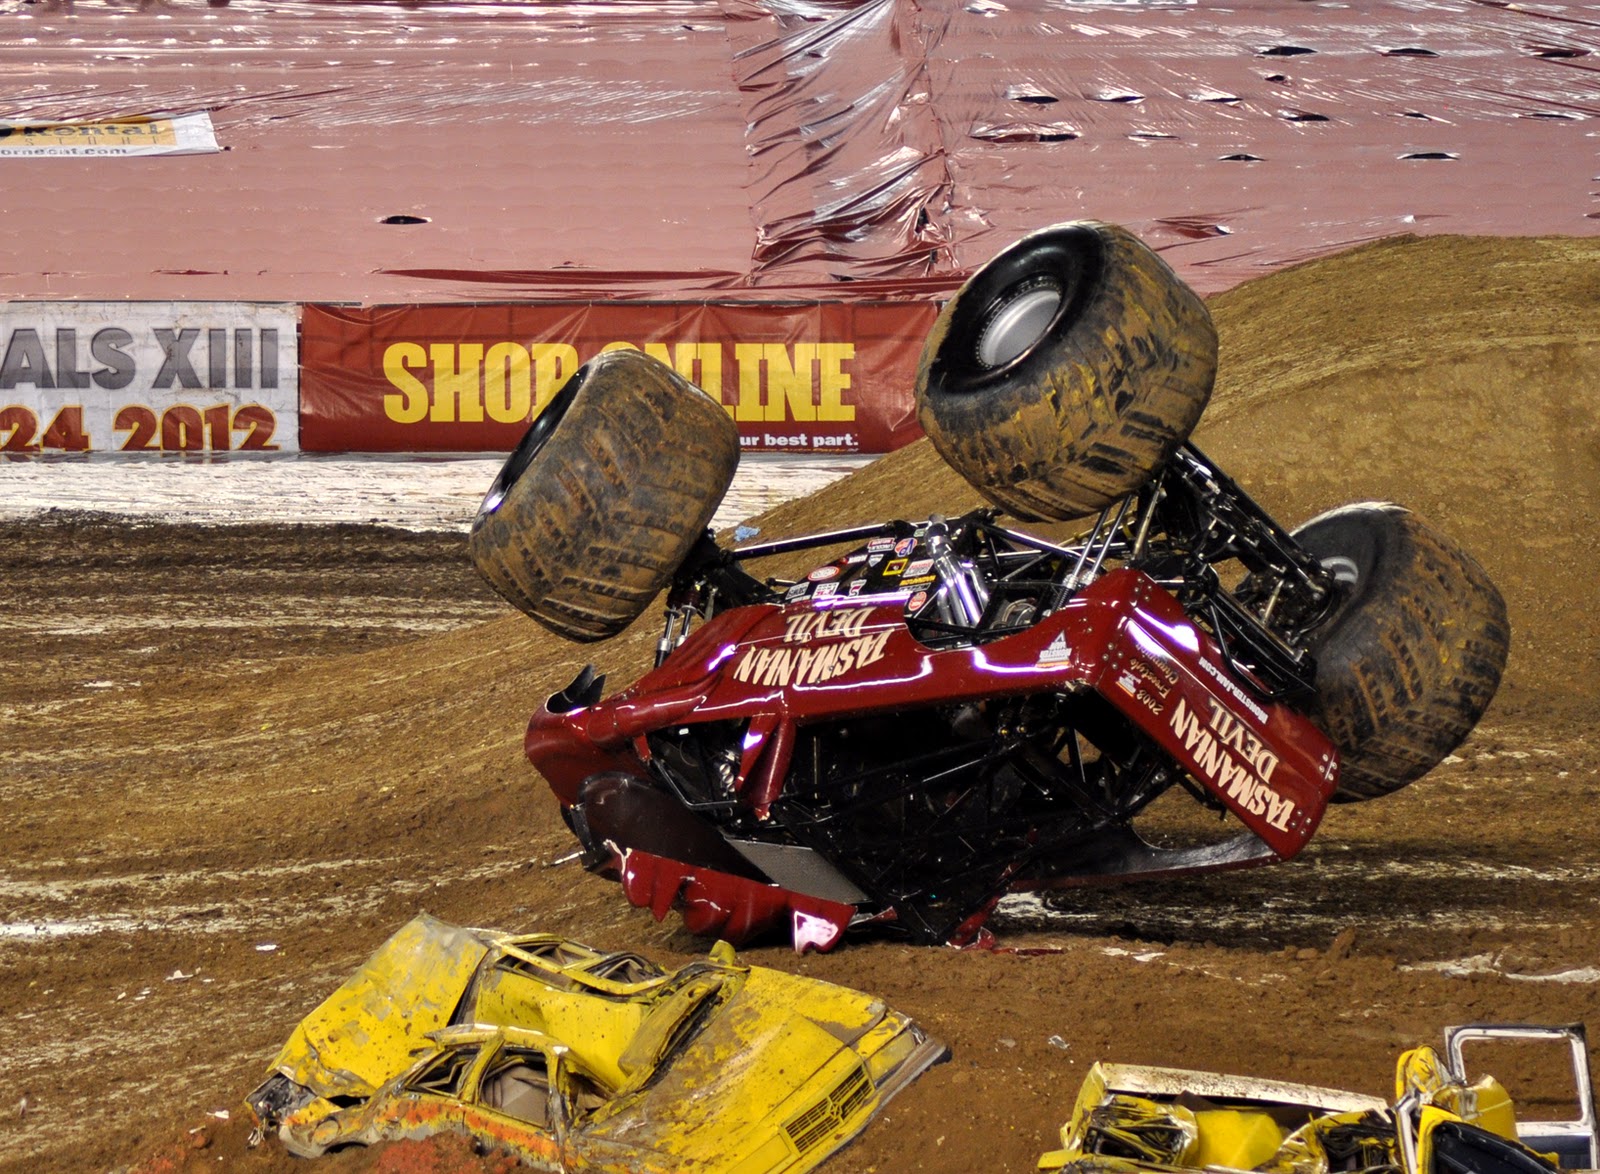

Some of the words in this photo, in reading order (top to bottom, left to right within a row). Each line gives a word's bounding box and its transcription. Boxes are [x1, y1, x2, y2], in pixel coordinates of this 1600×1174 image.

[0, 327, 136, 390] ALS
[152, 328, 278, 388] XIII
[383, 342, 578, 424] SHOP
[0, 404, 91, 451] 24
[113, 404, 281, 451] 2012
[740, 435, 760, 446] ur
[764, 433, 808, 446] best
[783, 606, 877, 643] DEVIL
[733, 627, 896, 686] TASMANIAN
[1130, 658, 1172, 699] Freestyle
[1136, 689, 1164, 715] 2008
[1169, 698, 1296, 832] TASMANIAN
[1209, 698, 1280, 784] DEVIL
